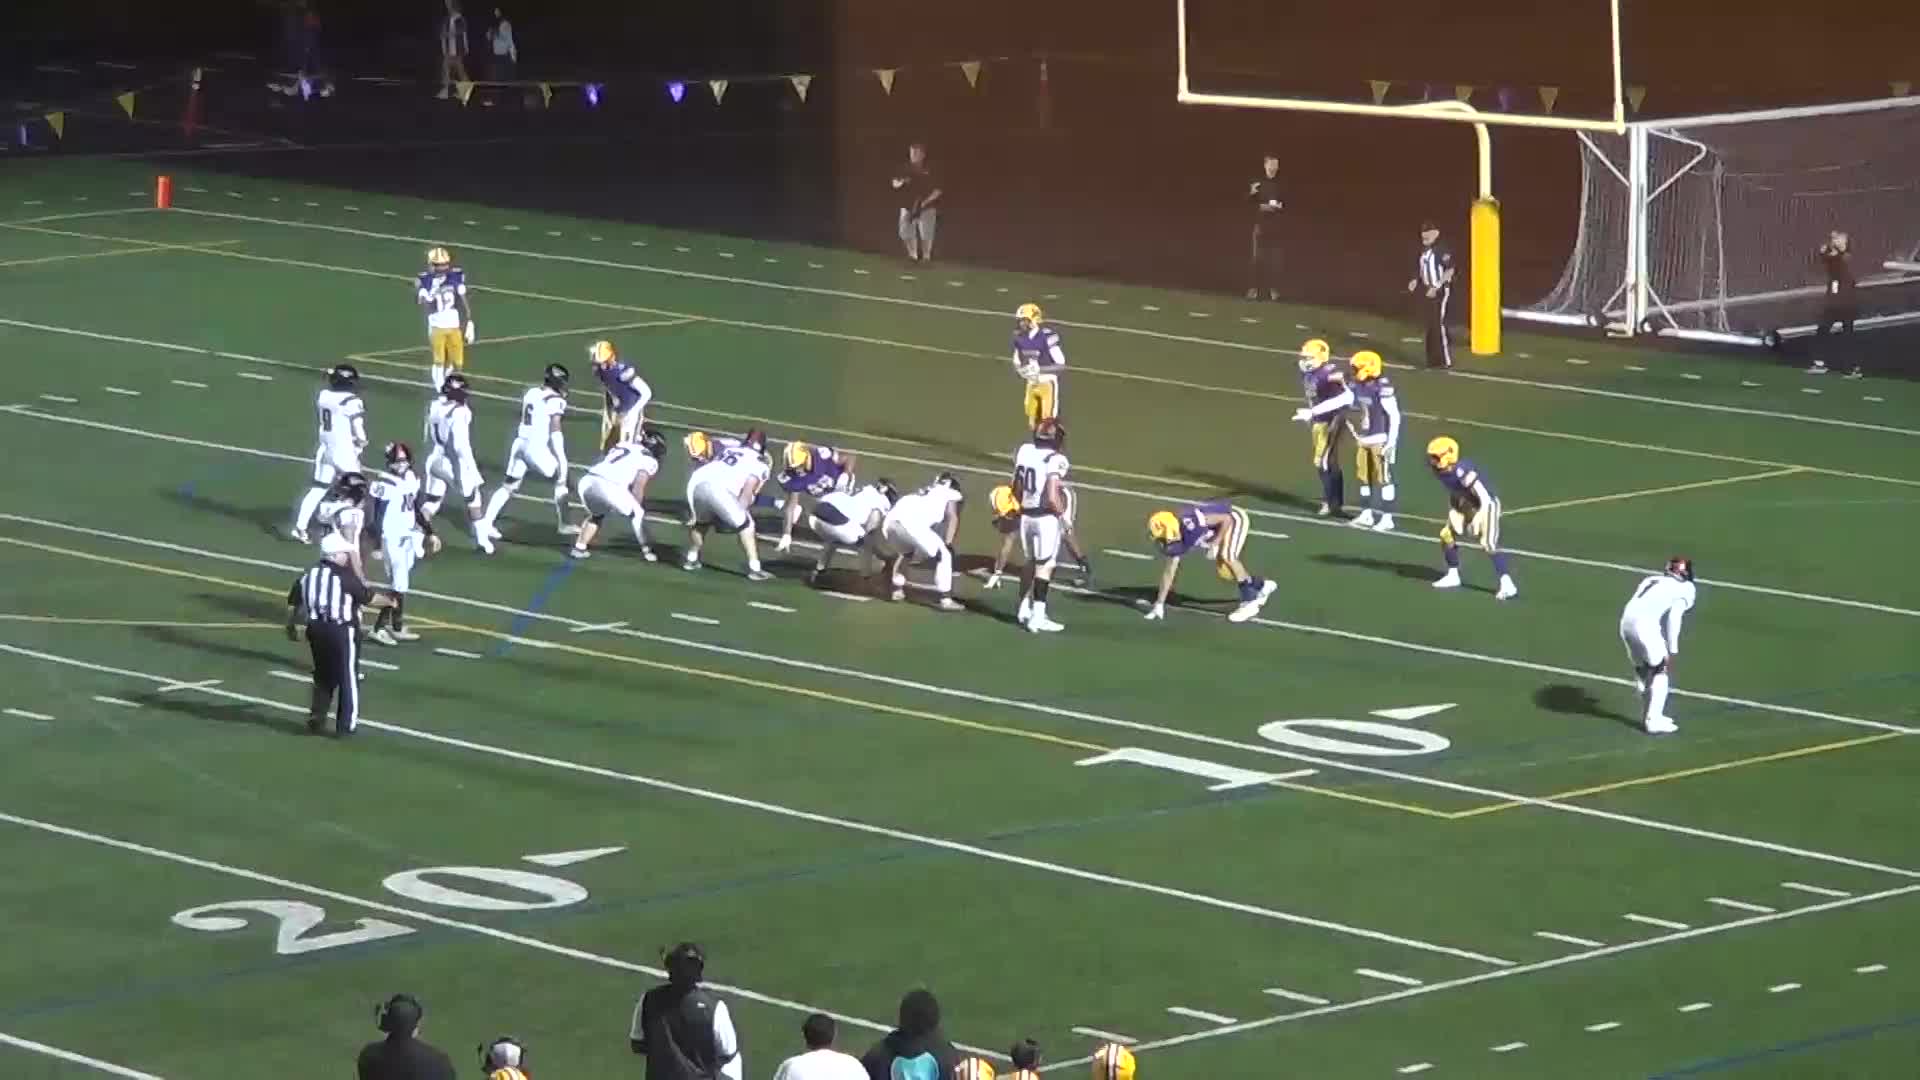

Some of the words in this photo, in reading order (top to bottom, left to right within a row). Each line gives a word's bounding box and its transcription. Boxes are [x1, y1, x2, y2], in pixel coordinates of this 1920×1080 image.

[435, 291, 455, 312] 12
[1015, 465, 1037, 494] 60
[1074, 719, 1450, 790] 10
[170, 867, 588, 954] 20
